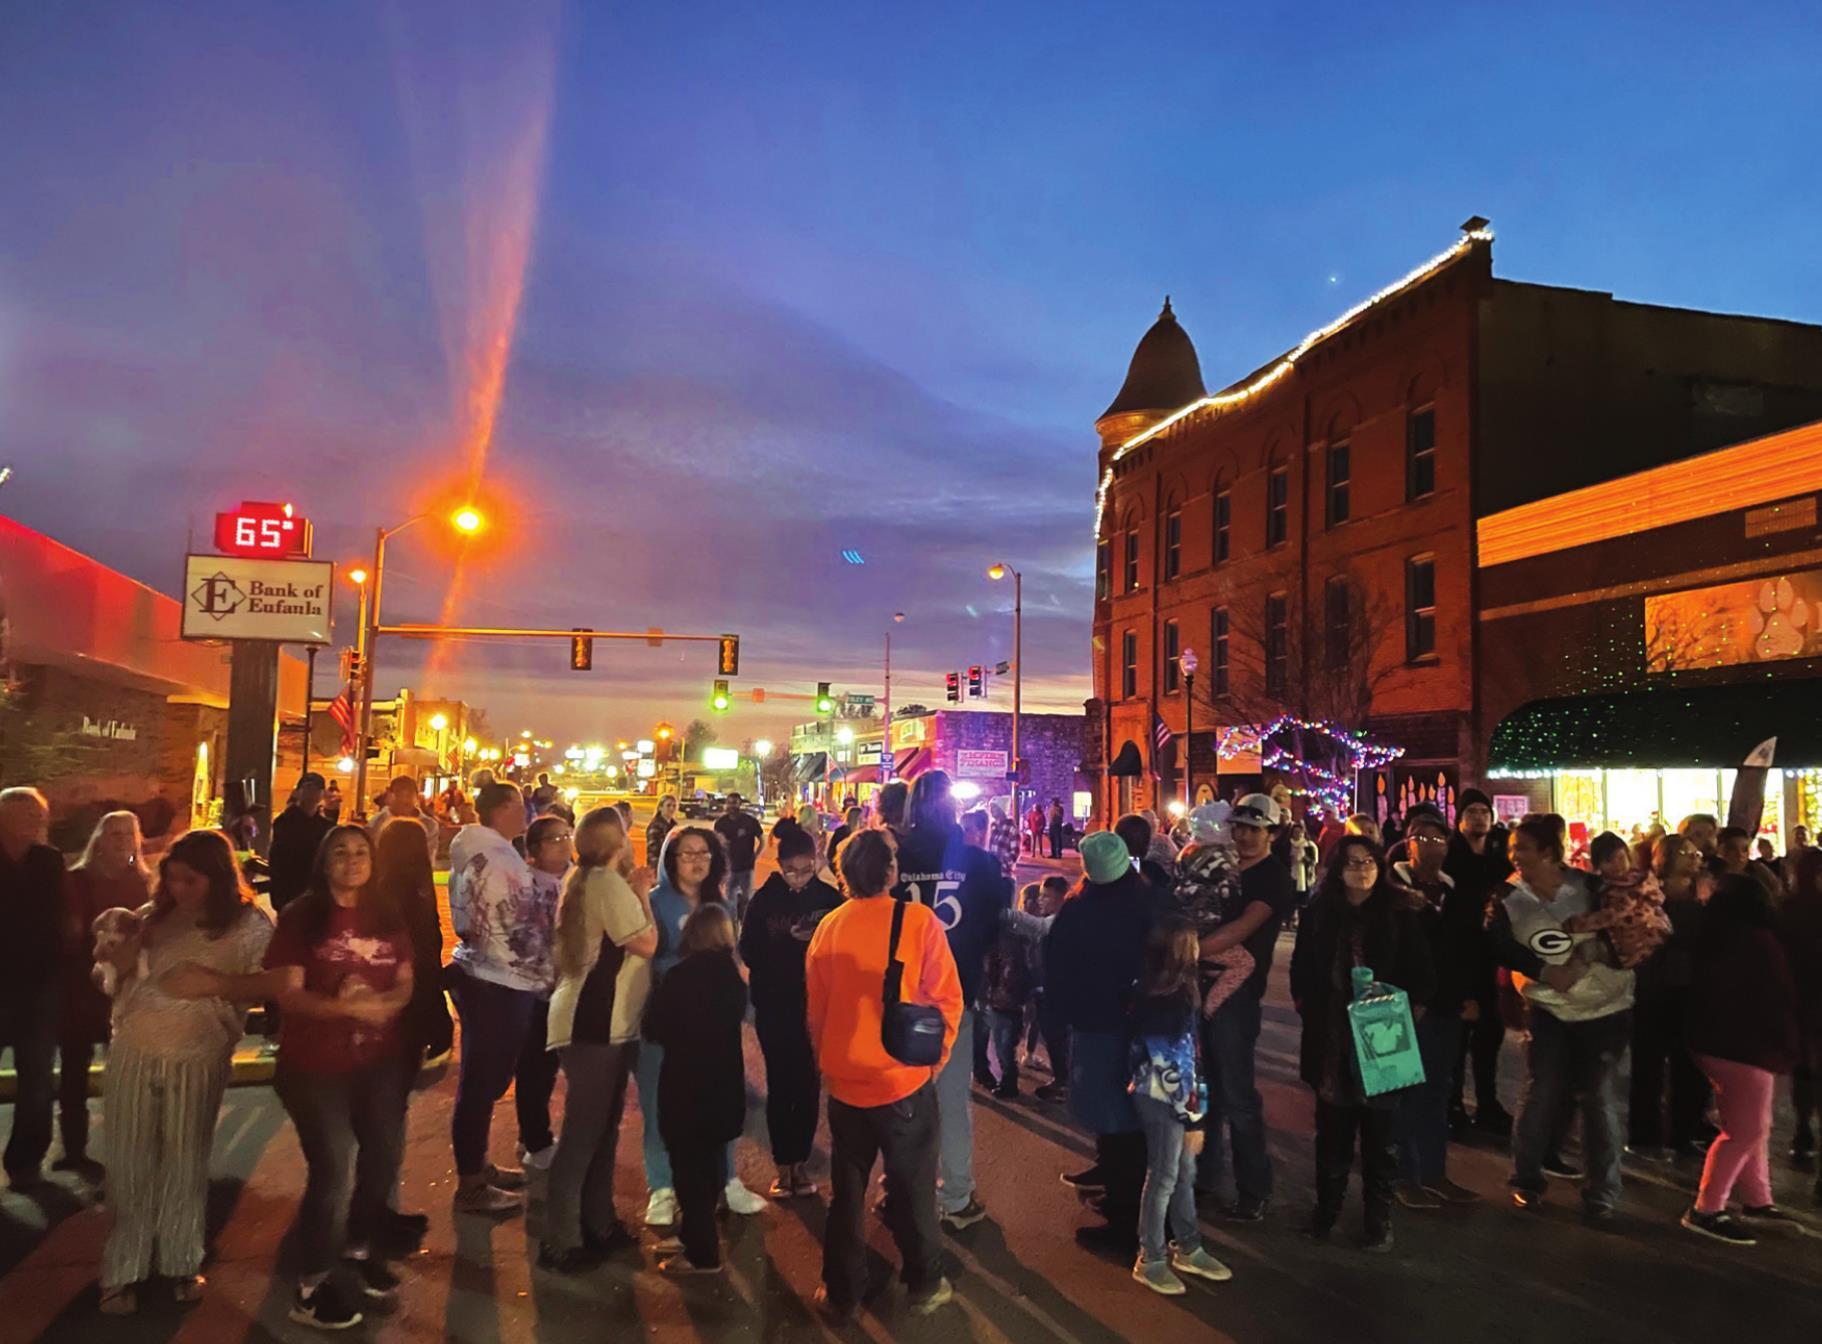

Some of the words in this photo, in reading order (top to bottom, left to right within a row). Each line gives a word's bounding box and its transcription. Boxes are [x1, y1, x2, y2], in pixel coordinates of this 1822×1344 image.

[248, 580, 299, 598] Bank
[303, 584, 324, 599] of
[901, 872, 944, 883] Oklahoma
[945, 869, 967, 882] City
[1530, 929, 1573, 955] G
